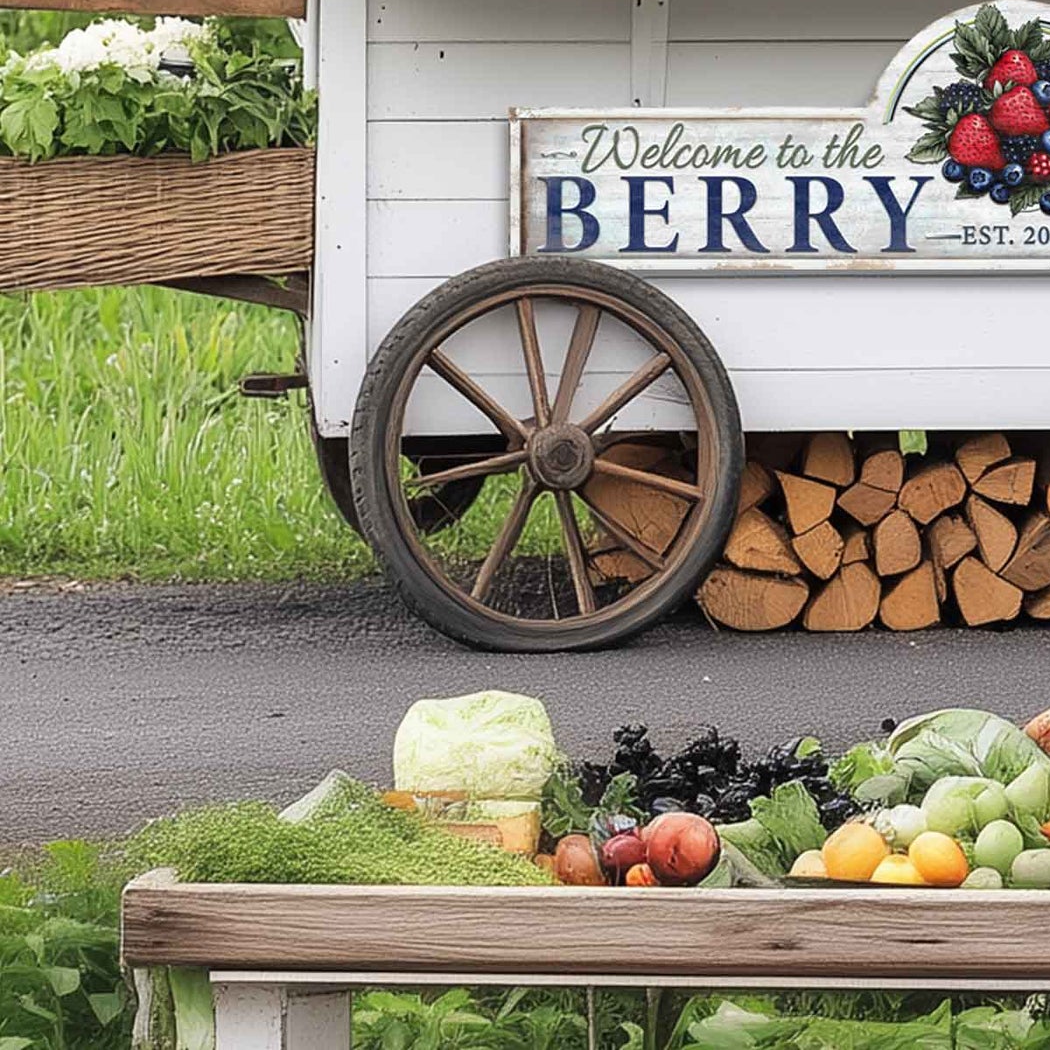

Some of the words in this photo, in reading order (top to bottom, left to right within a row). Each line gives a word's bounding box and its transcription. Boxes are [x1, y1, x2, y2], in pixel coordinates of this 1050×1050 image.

[580, 122, 767, 174] Welcome
[775, 133, 813, 169] to
[822, 122, 885, 169] the
[537, 175, 934, 253] BERRY
[961, 226, 1014, 245] EST.
